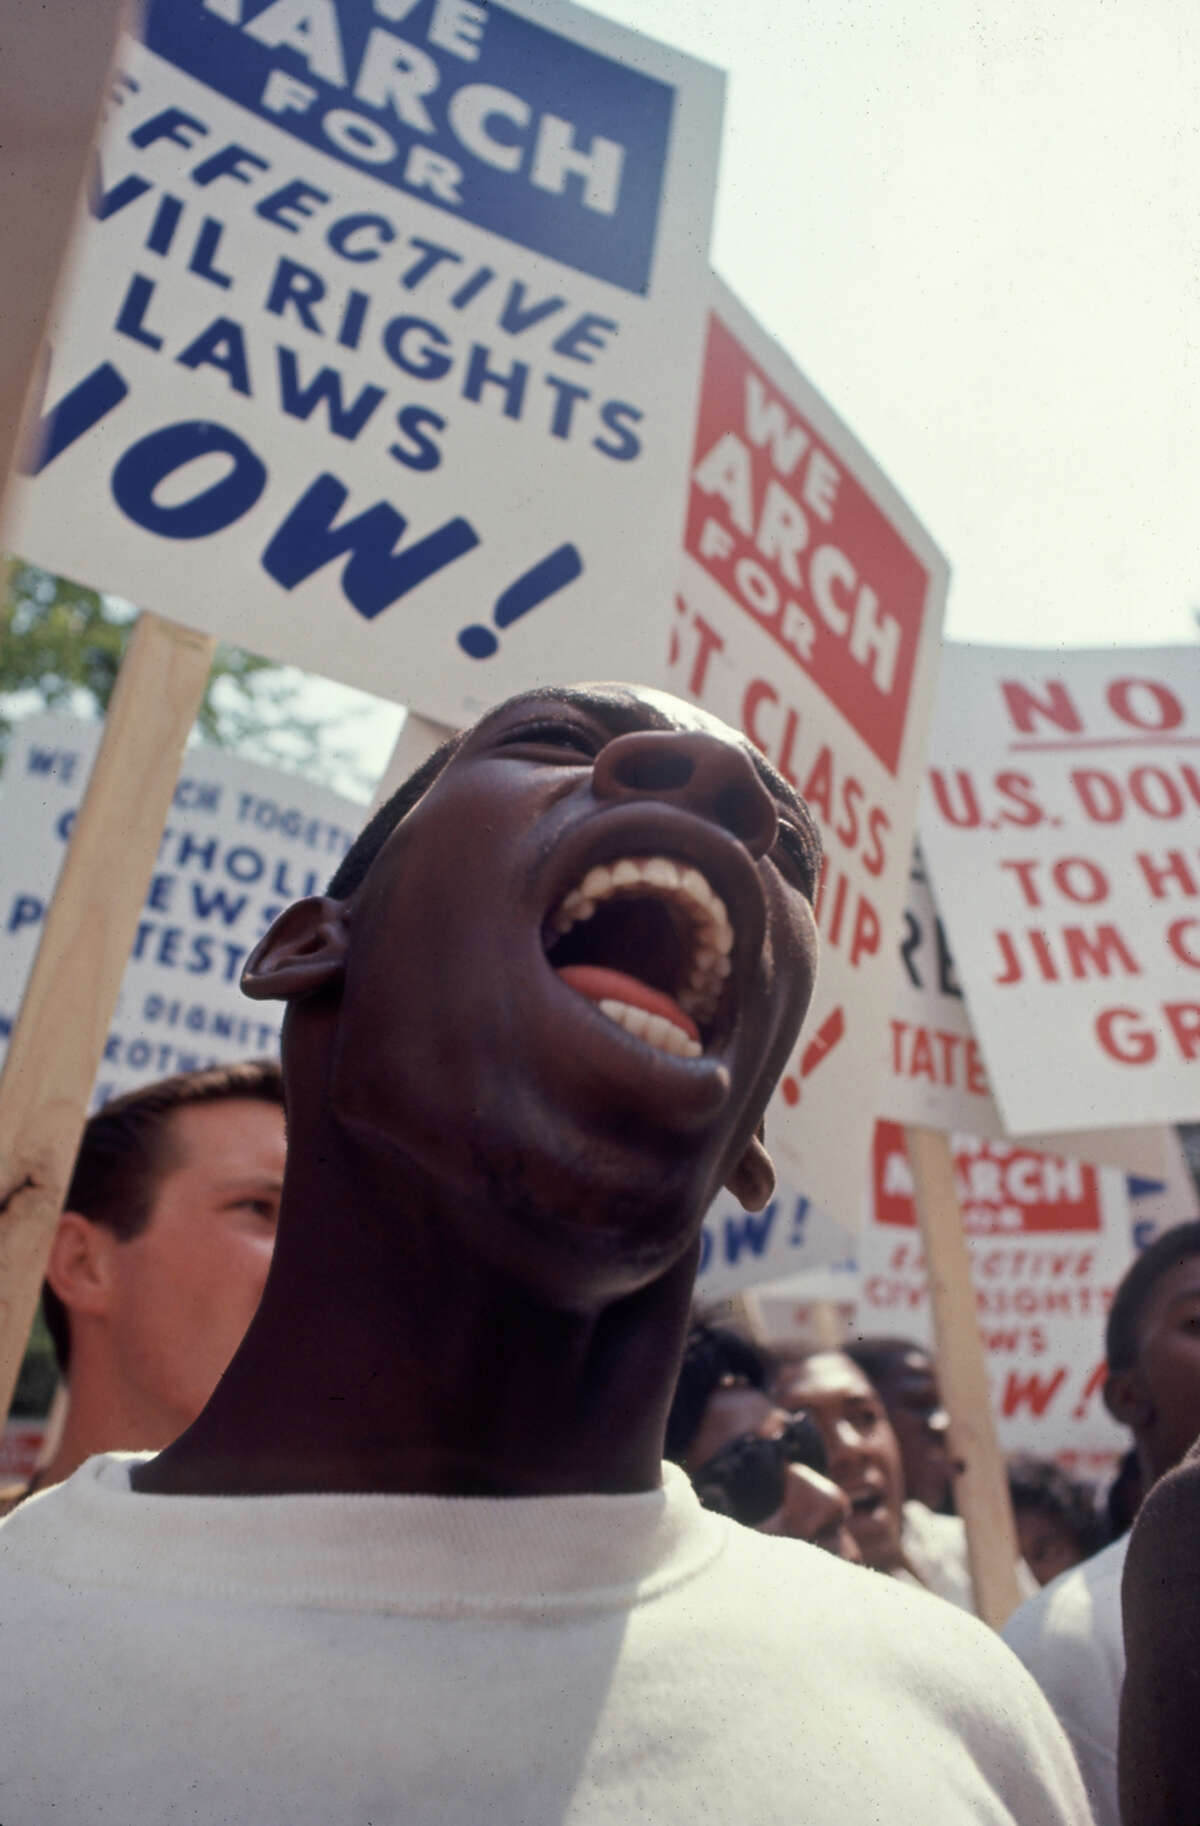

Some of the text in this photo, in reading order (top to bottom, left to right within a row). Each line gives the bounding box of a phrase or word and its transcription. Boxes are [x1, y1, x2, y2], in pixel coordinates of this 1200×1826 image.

[368, 0, 489, 62] E
[204, 0, 626, 216] ARCH
[260, 68, 464, 205] FOR
[113, 272, 448, 472] LAWS
[263, 255, 645, 463] RIGHTS
[744, 369, 843, 526] WE
[698, 514, 816, 662] FOR
[999, 676, 1185, 735] NO
[741, 677, 891, 878] CLASS
[928, 767, 1063, 829] U.S.
[1000, 856, 1110, 909] TO
[142, 993, 284, 1049] DIGNIT
[993, 924, 1142, 985] JIM
